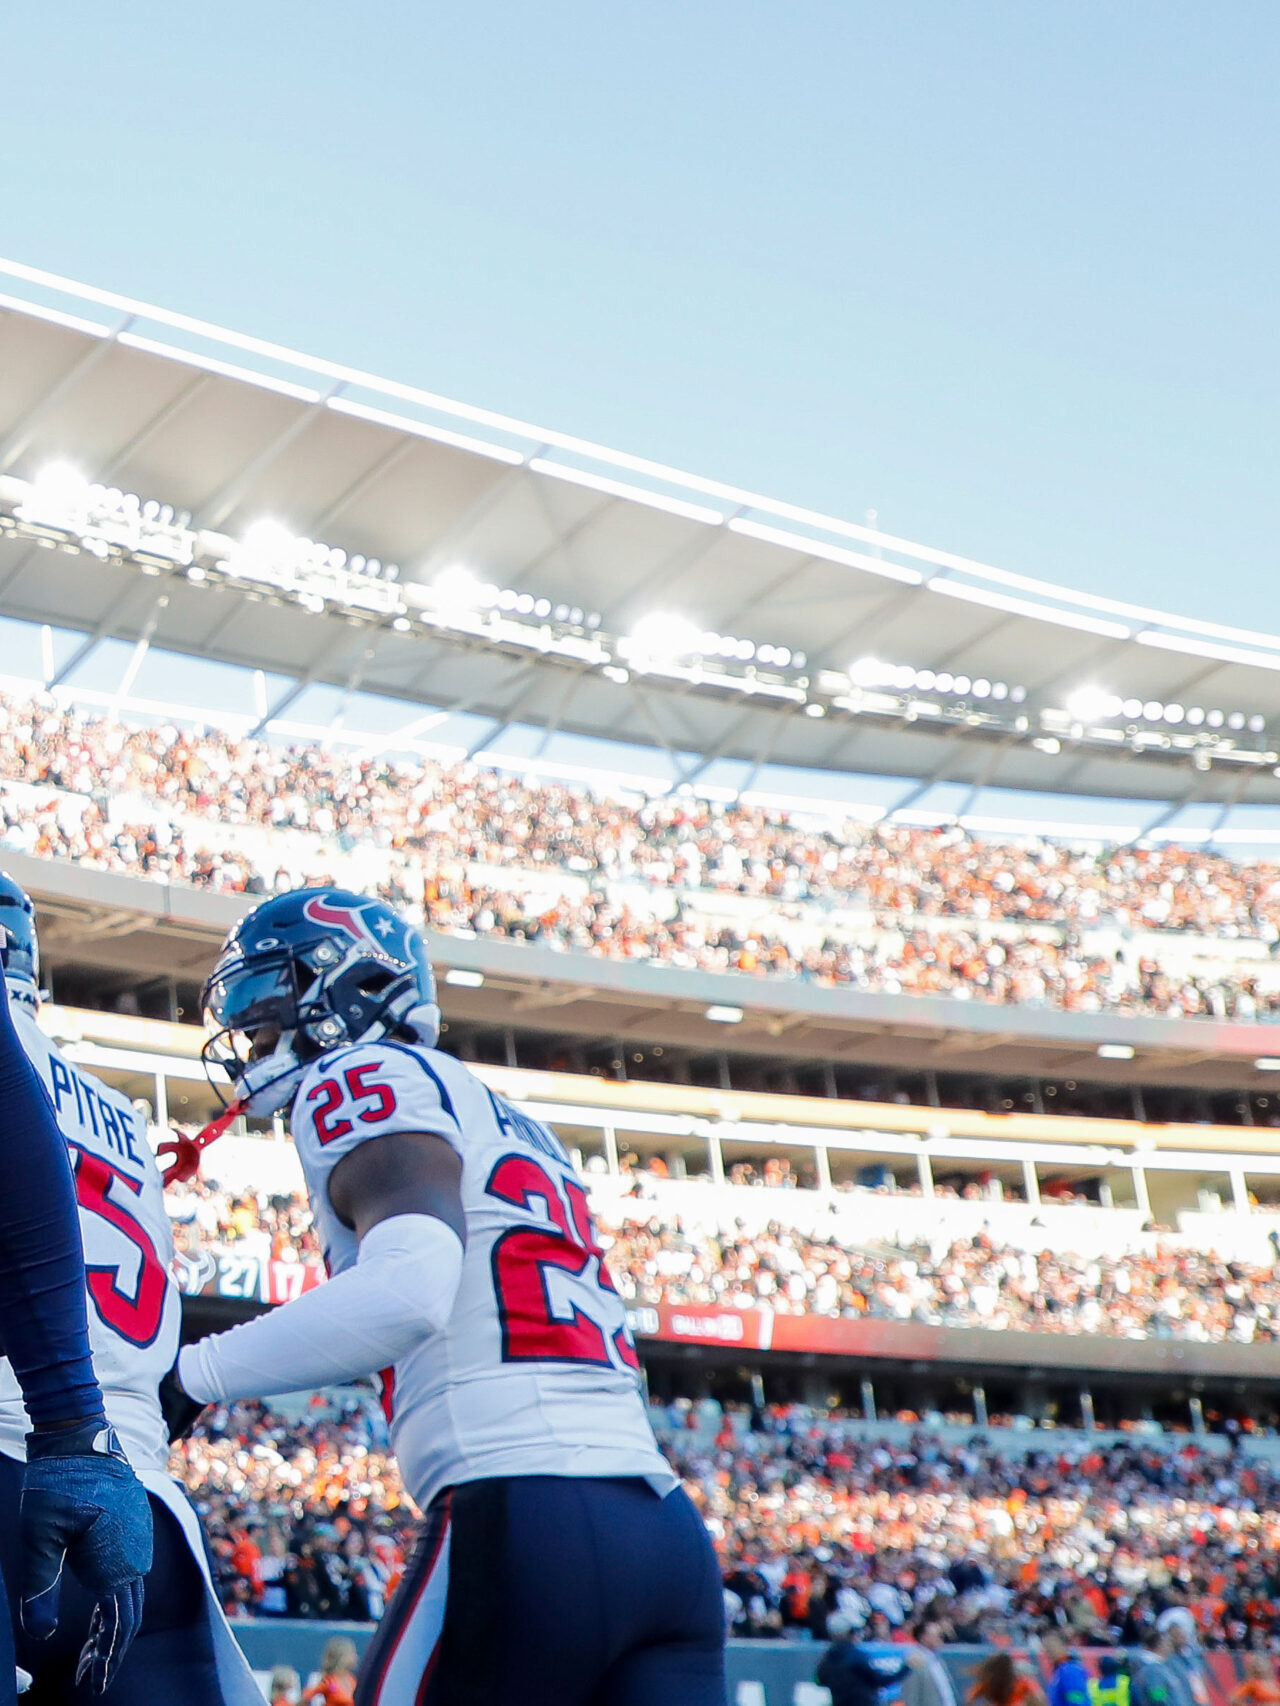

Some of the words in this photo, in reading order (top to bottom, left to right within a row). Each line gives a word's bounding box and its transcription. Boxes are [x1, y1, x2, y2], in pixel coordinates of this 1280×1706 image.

[48, 1052, 145, 1169] PITRE
[306, 1060, 396, 1147] 25
[68, 1143, 168, 1350] 5
[219, 1256, 259, 1298] 27
